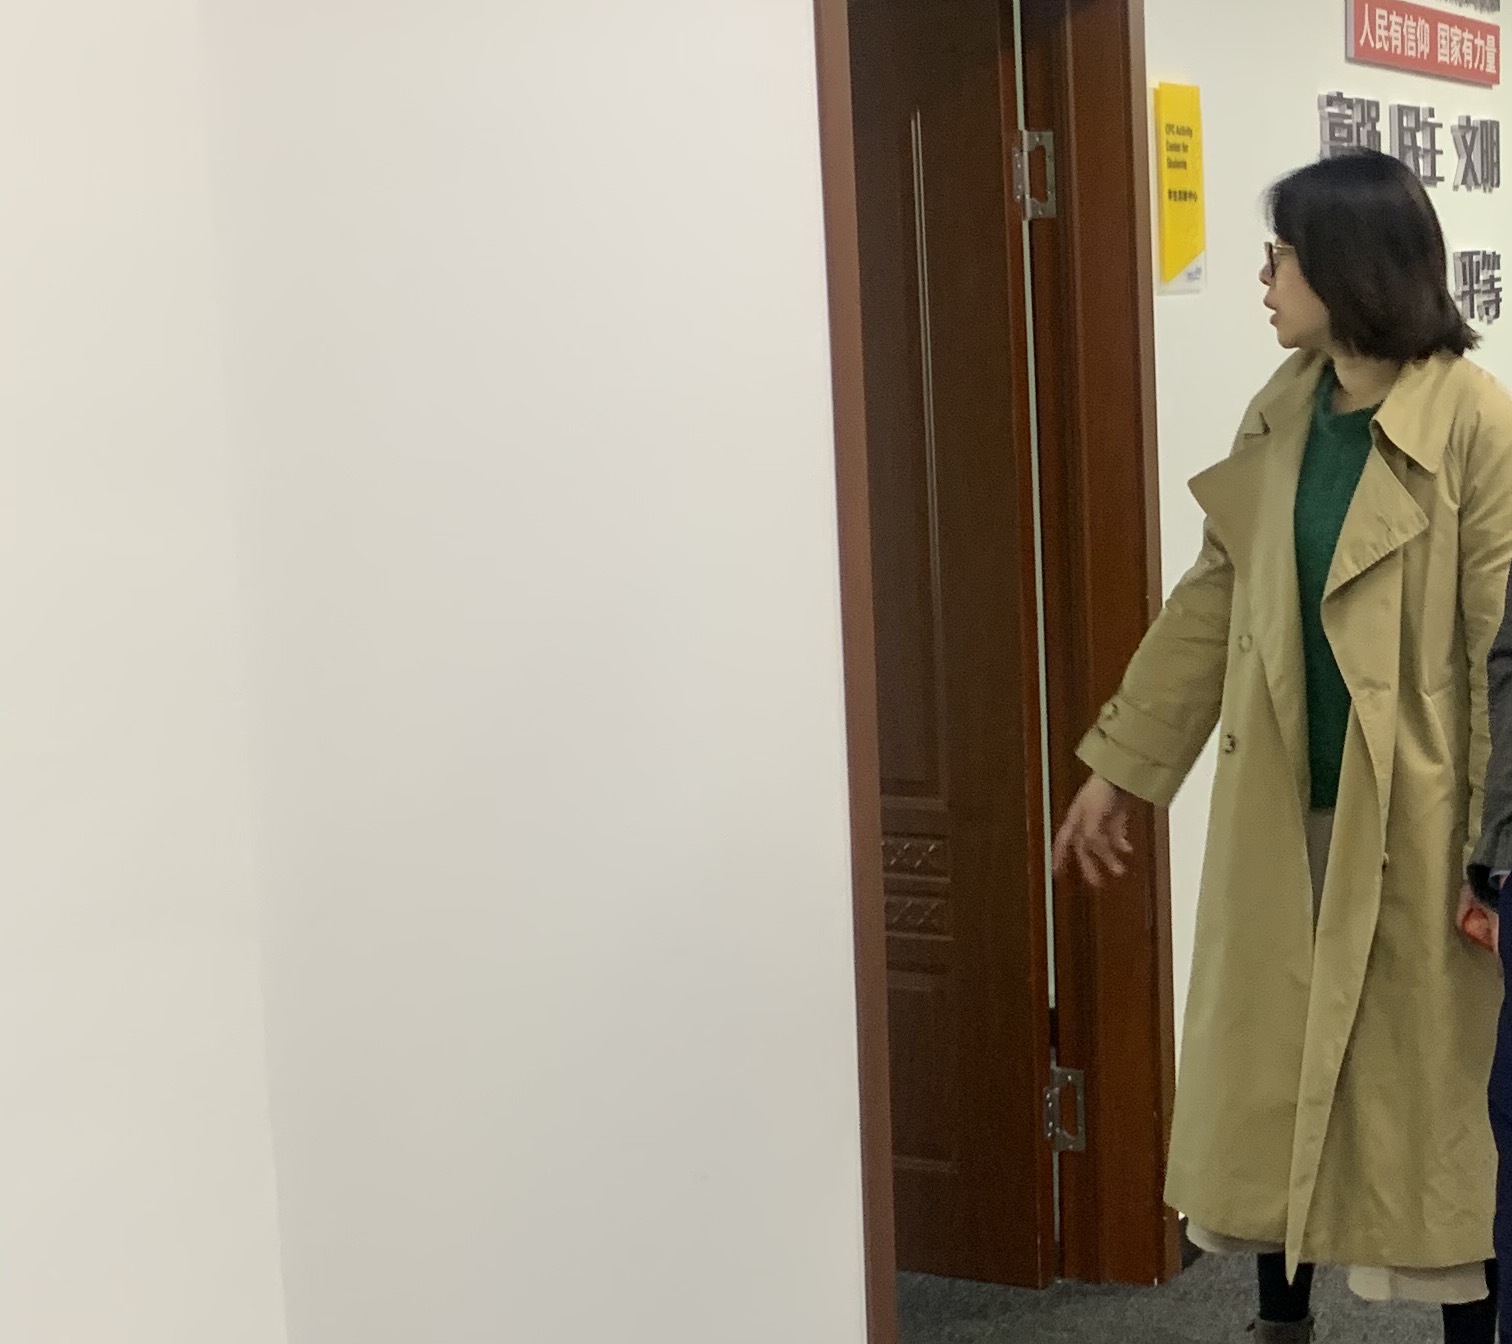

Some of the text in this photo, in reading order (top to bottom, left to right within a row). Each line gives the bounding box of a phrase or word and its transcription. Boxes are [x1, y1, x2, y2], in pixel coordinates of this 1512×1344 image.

[1359, 4, 1497, 74] 人民有信仰 国家有力量
[1450, 115, 1500, 192] 文明
[1453, 251, 1502, 324] 平等
